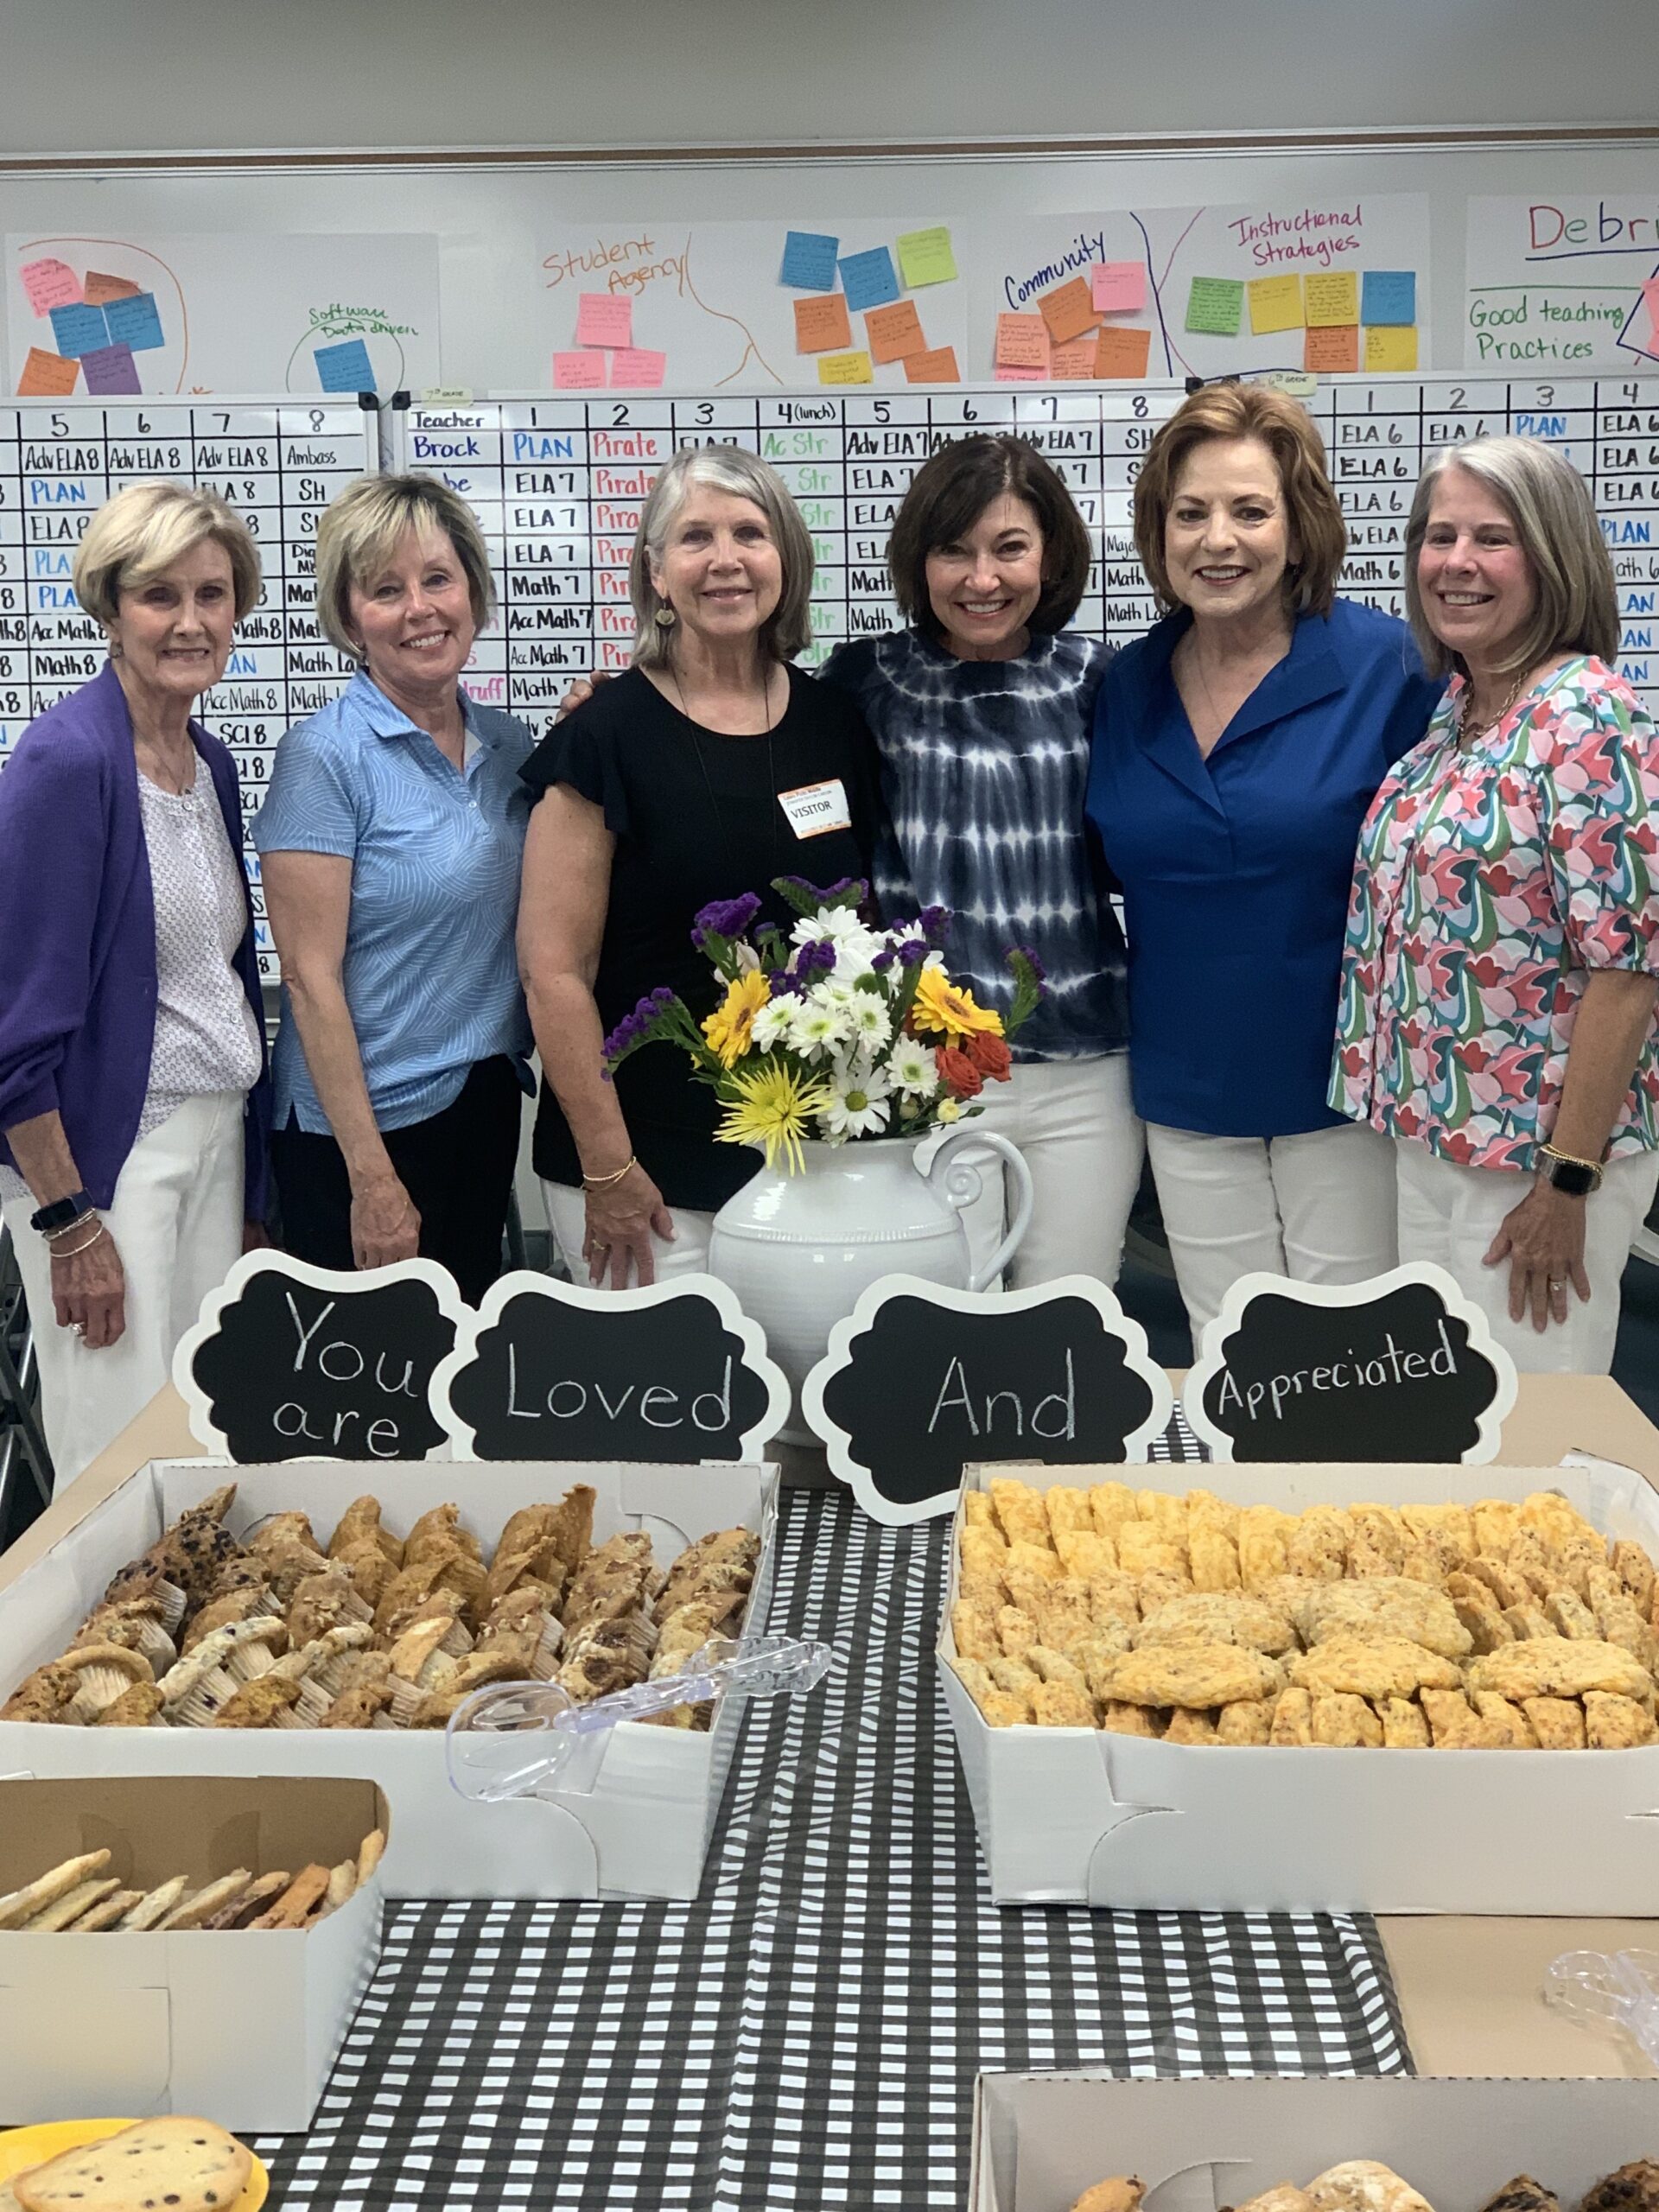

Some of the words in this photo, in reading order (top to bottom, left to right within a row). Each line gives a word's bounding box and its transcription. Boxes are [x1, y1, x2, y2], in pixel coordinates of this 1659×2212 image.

[1228, 205, 1363, 247] Instructional
[542, 233, 655, 288] Student
[1253, 234, 1360, 266] Strategies
[607, 256, 687, 296] Agency
[1004, 232, 1106, 310] Community
[1470, 296, 1527, 327] Good
[1540, 300, 1624, 329] teaching
[321, 322, 365, 338] Data
[1476, 333, 1593, 359] Practices
[1369, 391, 1373, 411] 1
[1449, 388, 1468, 409] 2
[1536, 385, 1554, 407] 3
[1623, 383, 1638, 404] 4
[531, 407, 537, 426] 1
[612, 404, 630, 426] 2
[695, 403, 714, 424] 3
[778, 403, 792, 423] 4
[794, 402, 836, 422] (lunch)
[873, 401, 891, 423] 5
[963, 400, 977, 421] 6
[1041, 397, 1058, 421] 7
[1132, 396, 1148, 417] 8
[51, 413, 69, 437] 5
[138, 413, 151, 433] 6
[212, 413, 230, 432] 7
[309, 410, 325, 432] 8
[410, 411, 485, 429] Teacher
[1516, 415, 1567, 436] PLAN
[1604, 415, 1641, 433] ELA
[1342, 425, 1379, 443] ELA
[1388, 423, 1402, 444] 6
[1429, 423, 1466, 441] ELA
[414, 435, 480, 458] Brock
[513, 433, 573, 461] PLAN
[594, 432, 658, 457] Pirate
[793, 432, 829, 455] Str
[287, 445, 337, 465] Ambass
[1604, 448, 1638, 467] ELA
[1340, 457, 1386, 477] ELA
[1393, 456, 1408, 477] 6
[516, 473, 556, 493] ELA
[559, 473, 575, 493] 7
[798, 467, 832, 492] Str
[852, 468, 895, 489] ELA
[30, 479, 86, 505] PLAN
[299, 479, 326, 501] SH
[1389, 490, 1403, 512] 6
[1605, 482, 1643, 501] ELA
[514, 509, 555, 528] ELA
[560, 509, 575, 527] 7
[596, 505, 639, 529] Pira
[30, 516, 73, 541] ELA
[1601, 519, 1649, 543] PLAN
[35, 550, 72, 576] PLA
[515, 544, 552, 563] ELA
[558, 545, 574, 562] 7
[1107, 565, 1145, 587] Math
[1389, 560, 1401, 580] 6
[288, 583, 318, 602] Mat
[512, 575, 561, 596] Math
[564, 575, 579, 594] 7
[39, 586, 77, 608] PLA
[537, 607, 580, 631] Math
[850, 607, 893, 632] Math
[1107, 602, 1141, 622] Math
[58, 619, 97, 641] Math
[35, 655, 82, 677] Math
[289, 648, 333, 673] Math
[530, 644, 569, 666] Math
[572, 645, 585, 664] 7
[230, 688, 265, 711] Math
[512, 677, 558, 701] Math
[219, 723, 250, 745] SCI
[254, 724, 266, 745] 8
[252, 757, 264, 779] 8
[791, 801, 833, 819] VISITOR
[286, 1291, 418, 1398] You
[1219, 1318, 1458, 1421] Appreciated
[506, 1343, 732, 1432] Loved
[927, 1347, 1076, 1442] And
[272, 1402, 401, 1458] are
